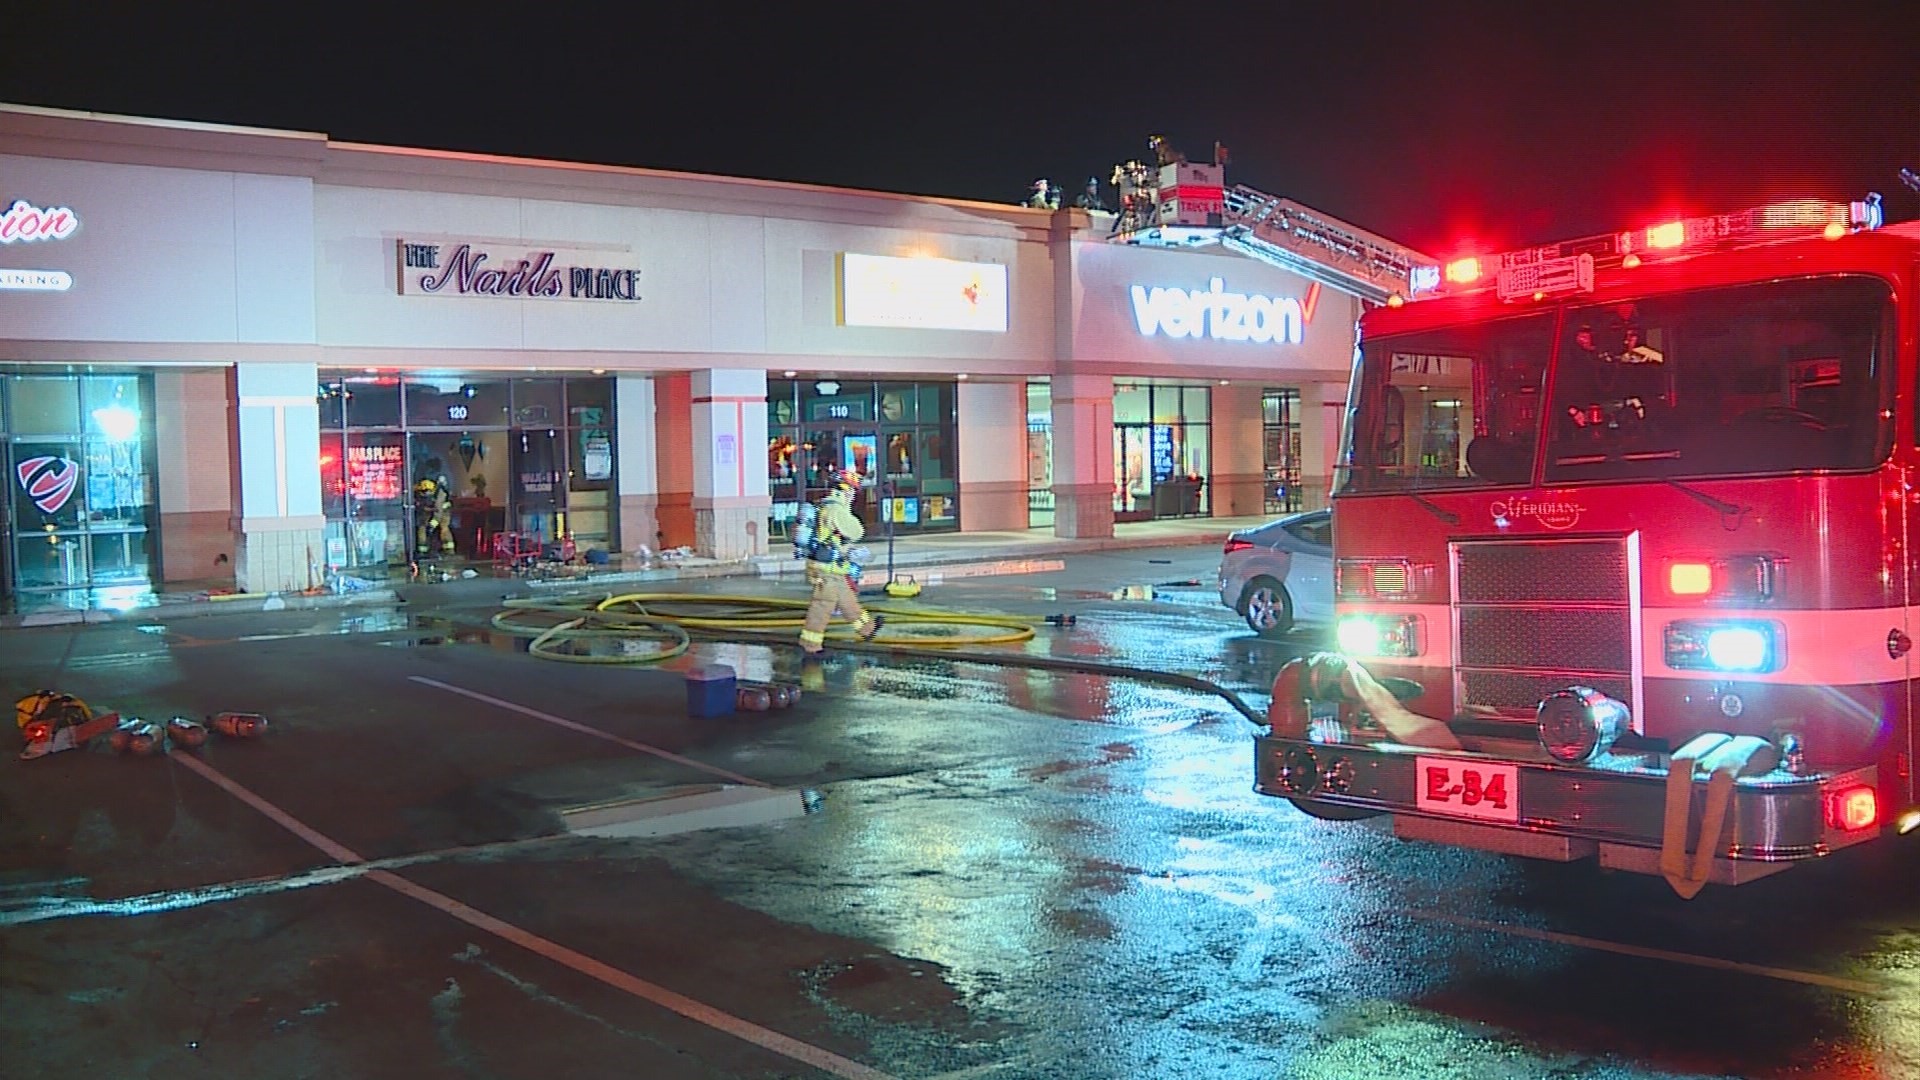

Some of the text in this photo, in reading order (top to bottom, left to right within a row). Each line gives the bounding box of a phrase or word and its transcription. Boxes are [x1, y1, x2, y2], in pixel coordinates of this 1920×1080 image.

[405, 243, 642, 300] THE Nails PLACE
[1131, 277, 1302, 344] verizon
[449, 406, 467, 419] 120
[830, 405, 848, 417] 110
[1426, 766, 1508, 810] E-34
